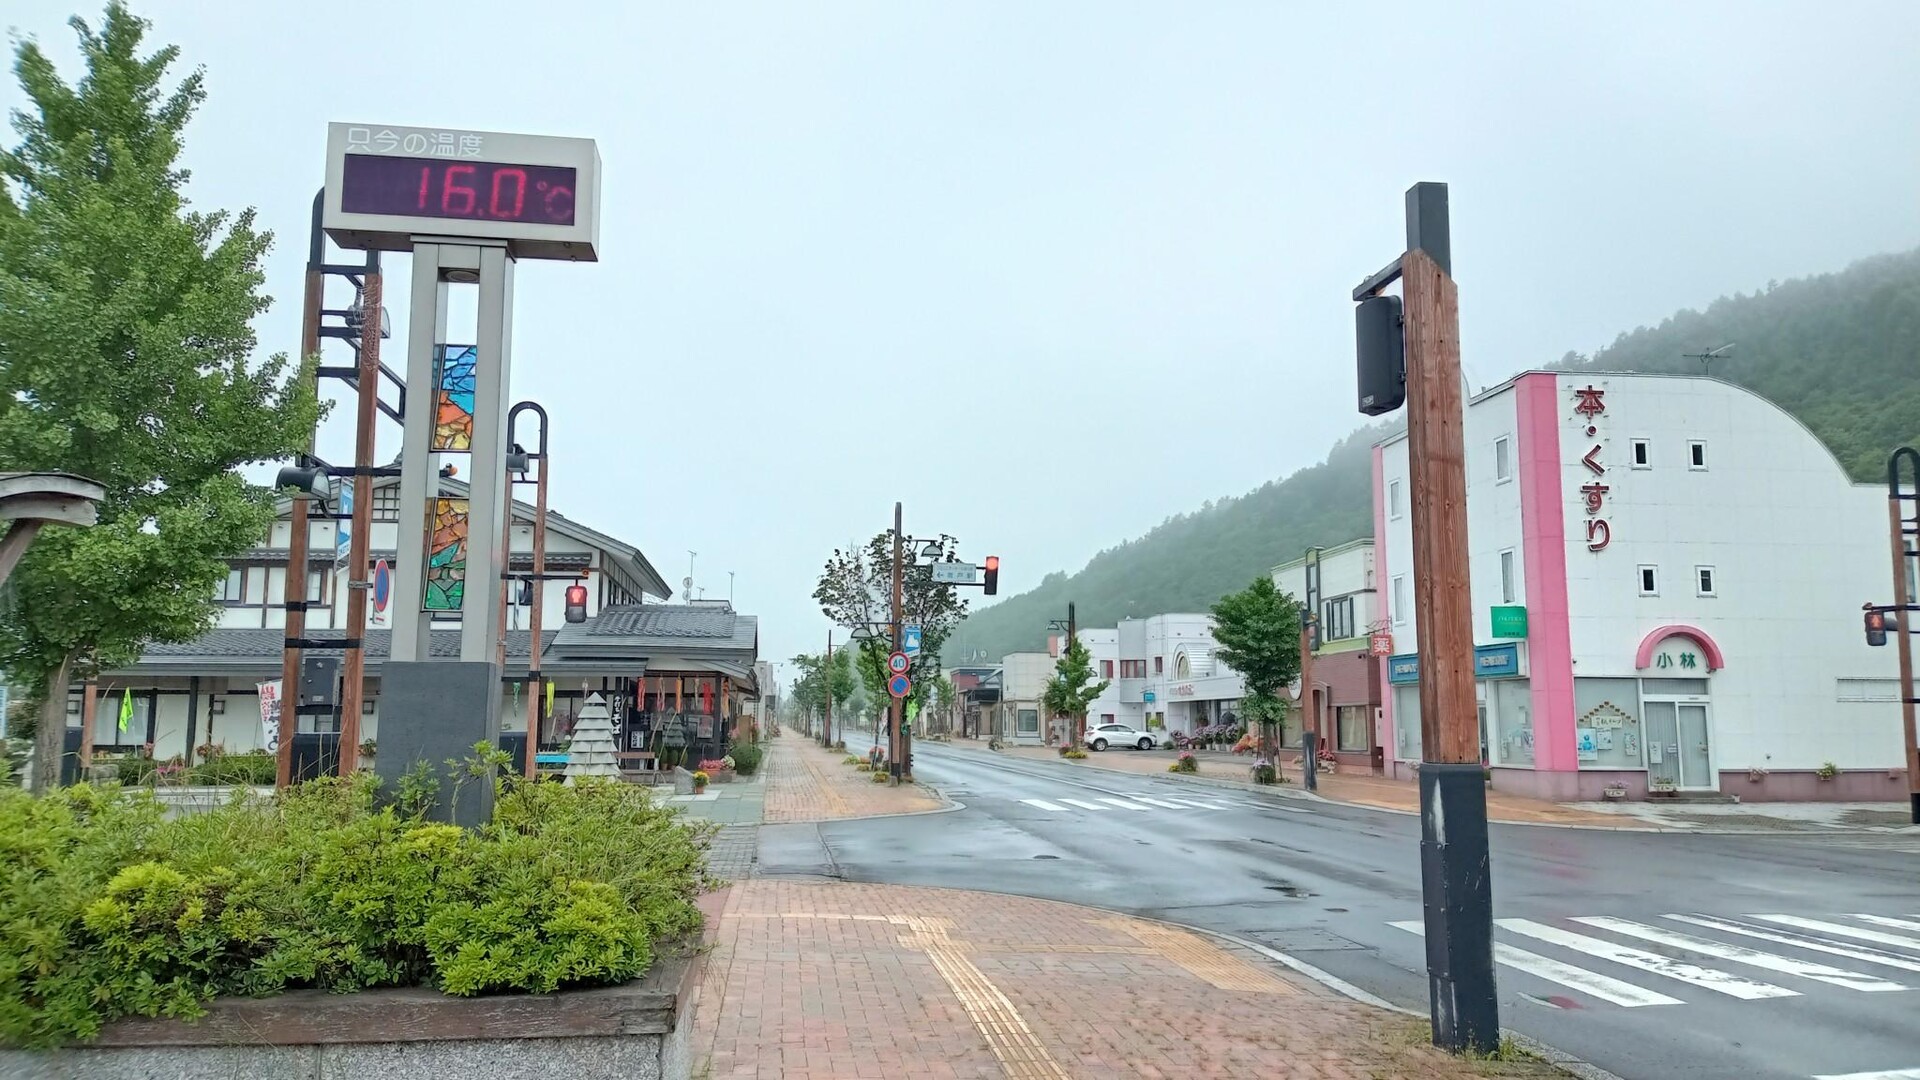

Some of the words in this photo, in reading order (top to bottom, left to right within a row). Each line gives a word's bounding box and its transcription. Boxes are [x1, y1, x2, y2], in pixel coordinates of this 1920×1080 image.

[346, 127, 484, 157] 只今の温度
[1575, 384, 1611, 551] 本・くすり
[1373, 637, 1391, 653] 薬
[892, 658, 905, 669] 40
[1656, 652, 1697, 669] 小林
